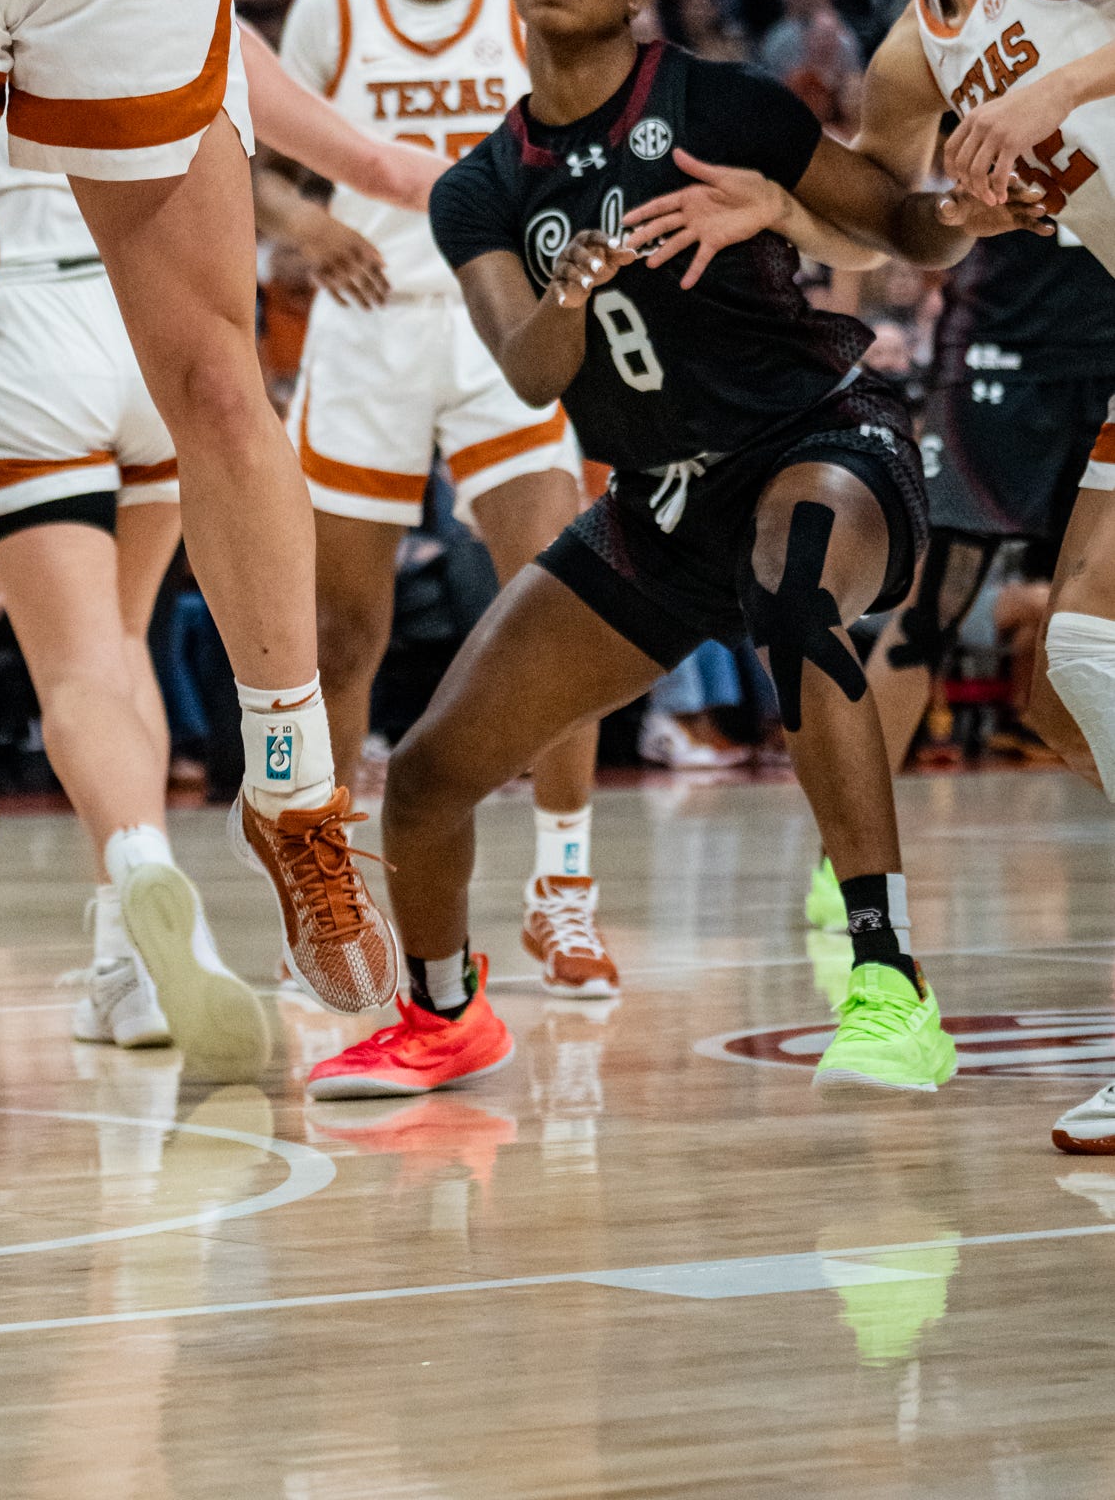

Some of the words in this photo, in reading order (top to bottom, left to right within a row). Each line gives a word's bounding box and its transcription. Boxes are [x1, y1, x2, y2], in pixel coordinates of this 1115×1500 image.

[366, 77, 508, 121] TEXAS
[632, 122, 668, 157] SEC
[593, 289, 664, 393] 8
